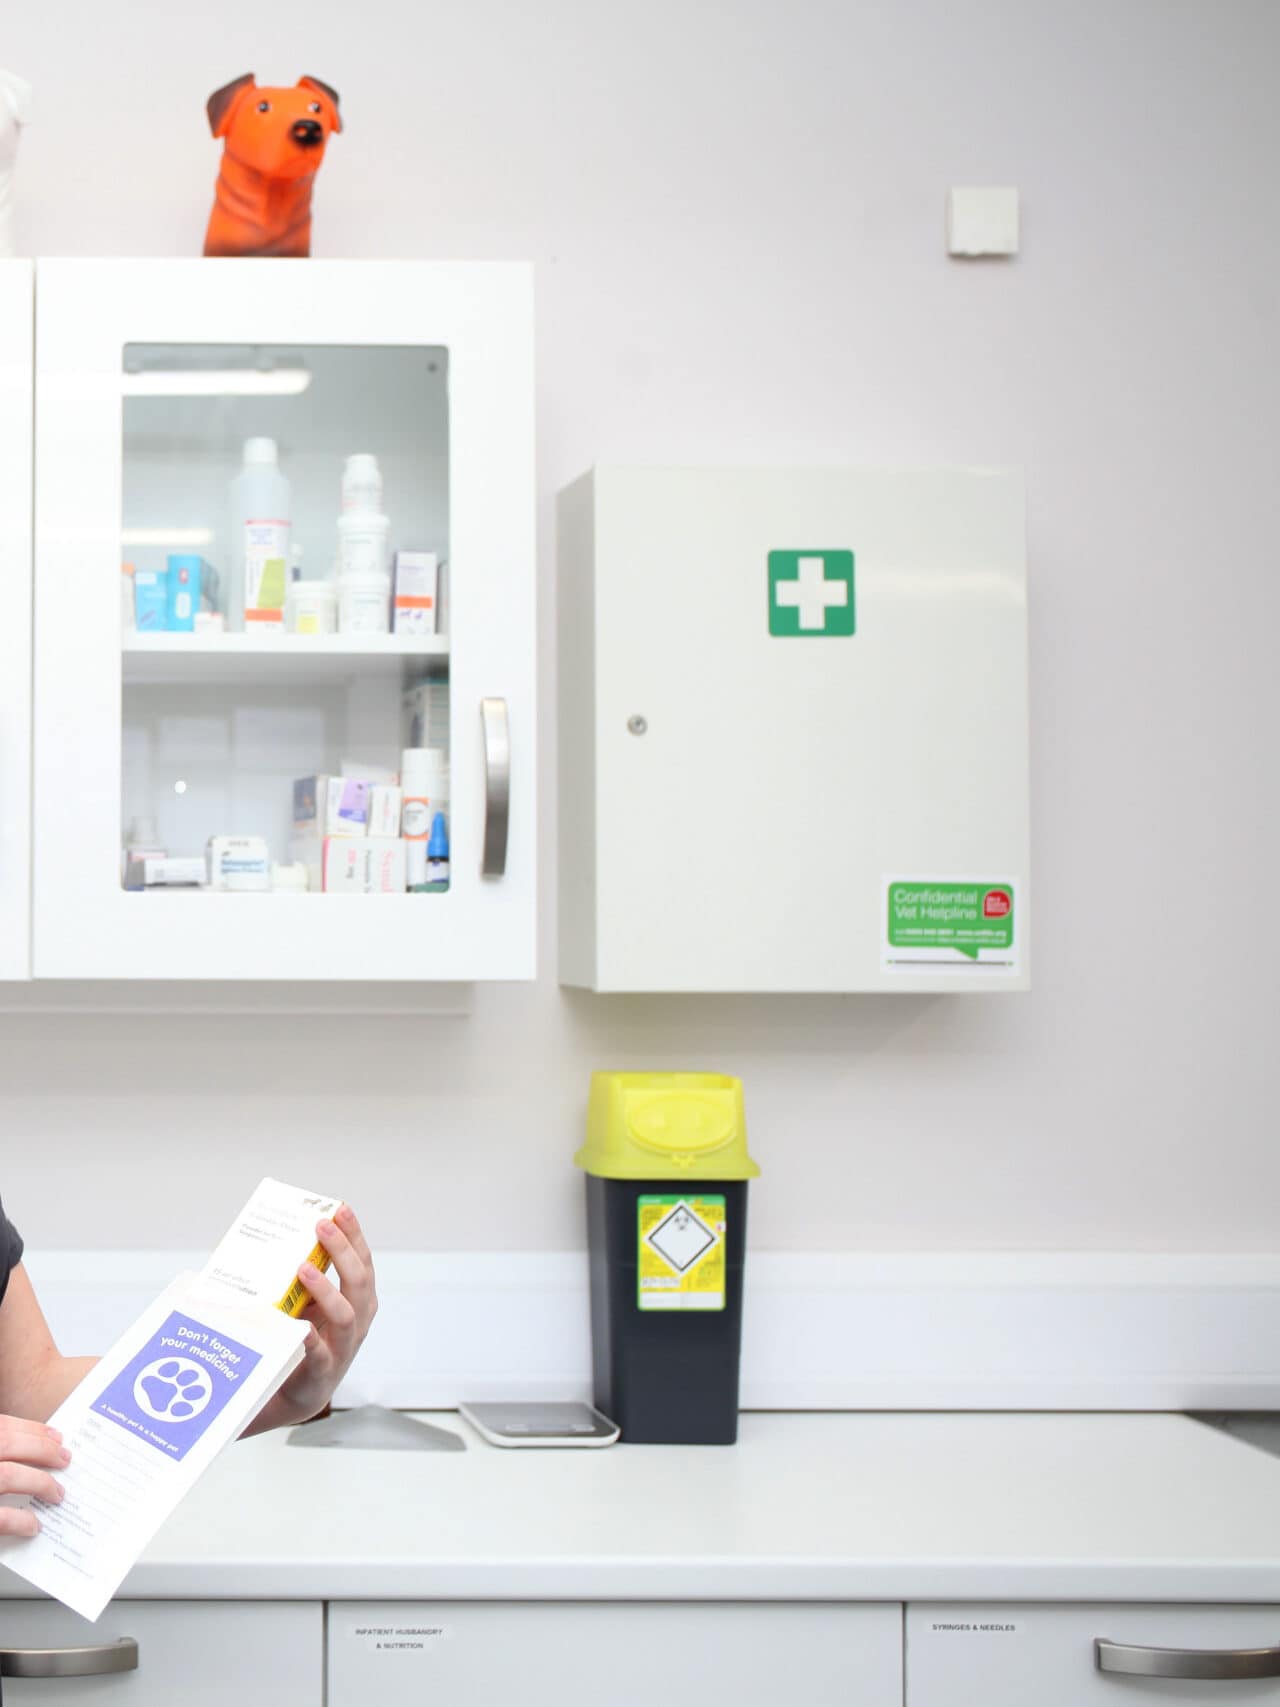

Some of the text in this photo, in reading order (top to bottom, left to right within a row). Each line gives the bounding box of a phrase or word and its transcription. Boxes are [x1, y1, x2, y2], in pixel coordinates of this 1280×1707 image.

[893, 889, 977, 905] Confidential
[894, 906, 977, 921] Vet Helpline
[177, 1326, 241, 1364] Don't forget
[160, 1336, 240, 1382] your medicine!
[355, 1628, 443, 1636] INPATIENT HUSBANDRY
[932, 1623, 1016, 1632] SYRINGES & NEEDLES
[375, 1642, 424, 1650] & NUTRITION
